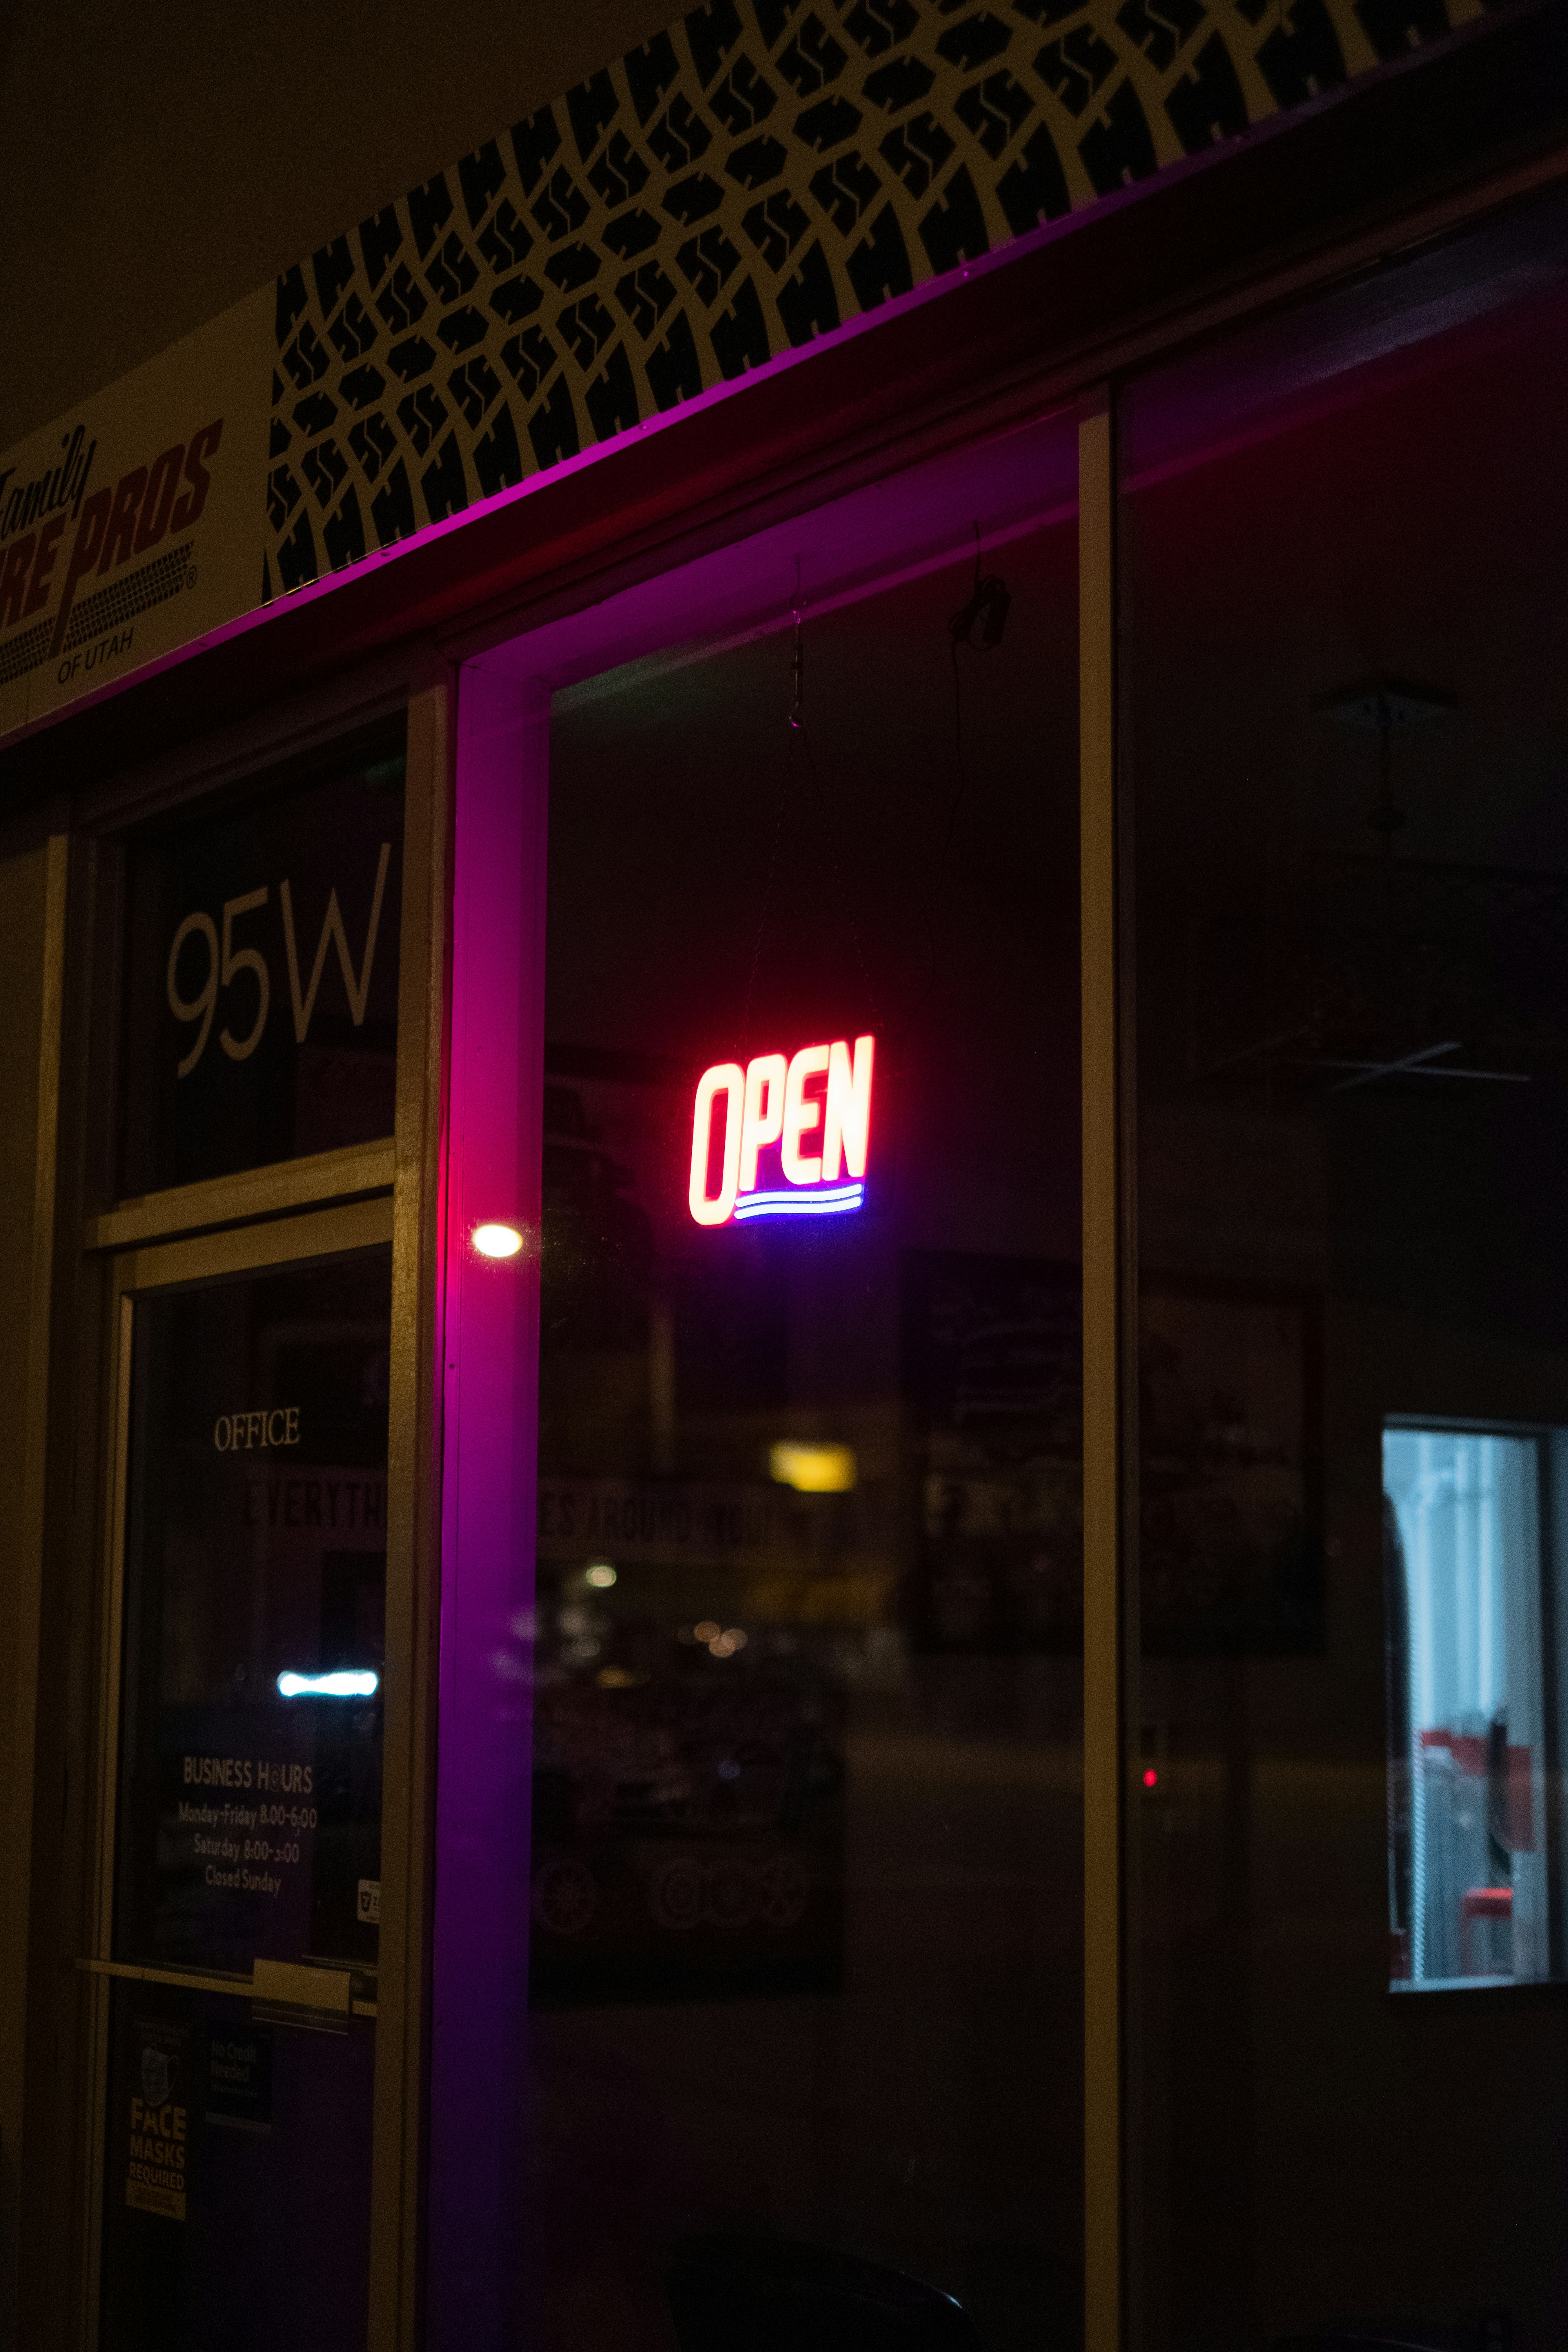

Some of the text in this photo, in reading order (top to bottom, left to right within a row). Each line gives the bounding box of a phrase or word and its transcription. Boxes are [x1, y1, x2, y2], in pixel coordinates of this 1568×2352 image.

[0, 418, 224, 661] RE PROS
[58, 627, 134, 684] OF UTAH
[688, 1034, 875, 1226] OPEN
[214, 1406, 301, 1451] OFFICE
[243, 1479, 383, 1526] EVERYTH
[183, 1756, 252, 1788] BUSINESS
[178, 1801, 257, 1830] Monday-Friday
[194, 1833, 240, 1863] Saturday
[205, 1864, 282, 1898] Closed Sunday
[130, 2097, 187, 2141] FACE
[129, 2134, 185, 2169] MASKS
[129, 2162, 185, 2191] REQUIRED
